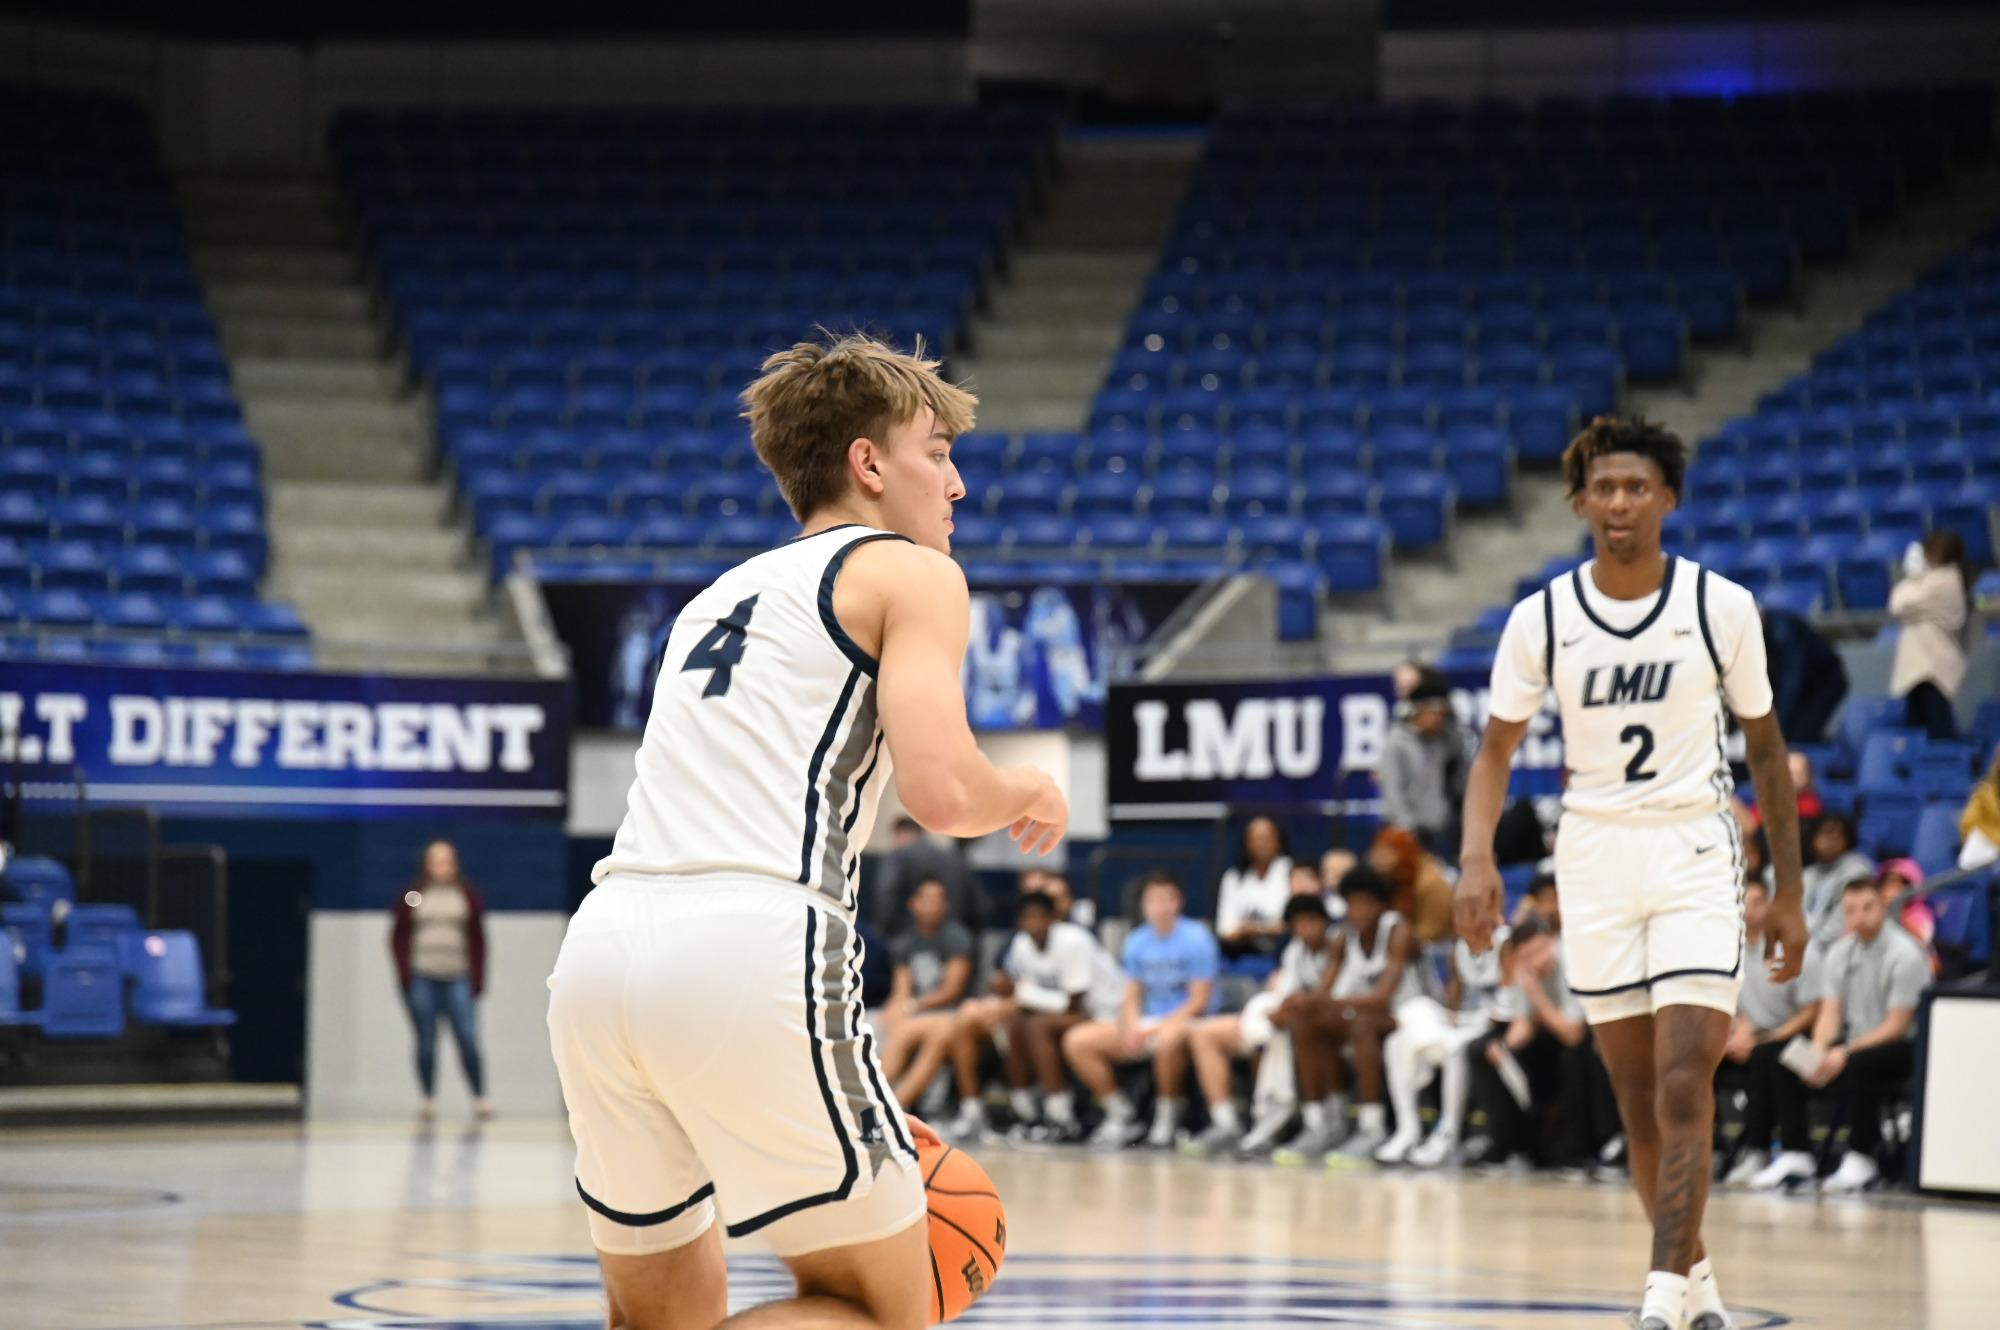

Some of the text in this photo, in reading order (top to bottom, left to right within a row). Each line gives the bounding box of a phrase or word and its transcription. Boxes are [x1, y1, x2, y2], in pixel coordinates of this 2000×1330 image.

[679, 592, 761, 700] 4
[1581, 659, 1683, 709] LMU
[108, 694, 544, 771] DIFFERENT
[1133, 696, 1325, 778] LMU
[1619, 724, 1657, 782] 2
